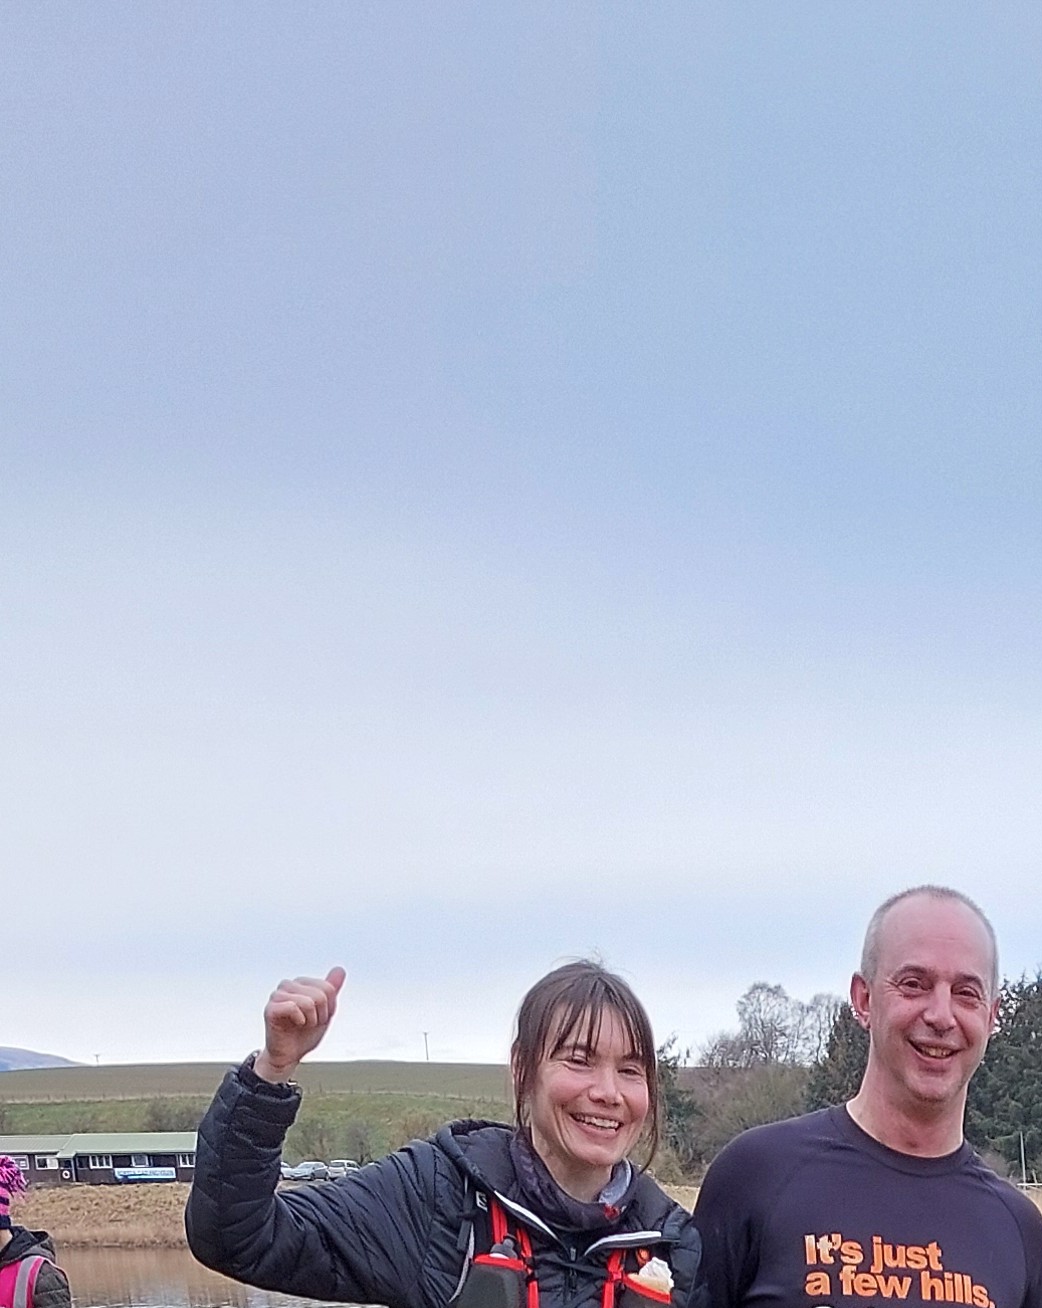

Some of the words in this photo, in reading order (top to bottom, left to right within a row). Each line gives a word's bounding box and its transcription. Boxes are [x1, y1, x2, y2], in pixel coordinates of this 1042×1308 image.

[804, 1234, 863, 1265] It's
[870, 1236, 943, 1274] just
[805, 1272, 831, 1296] a
[839, 1265, 911, 1299] few
